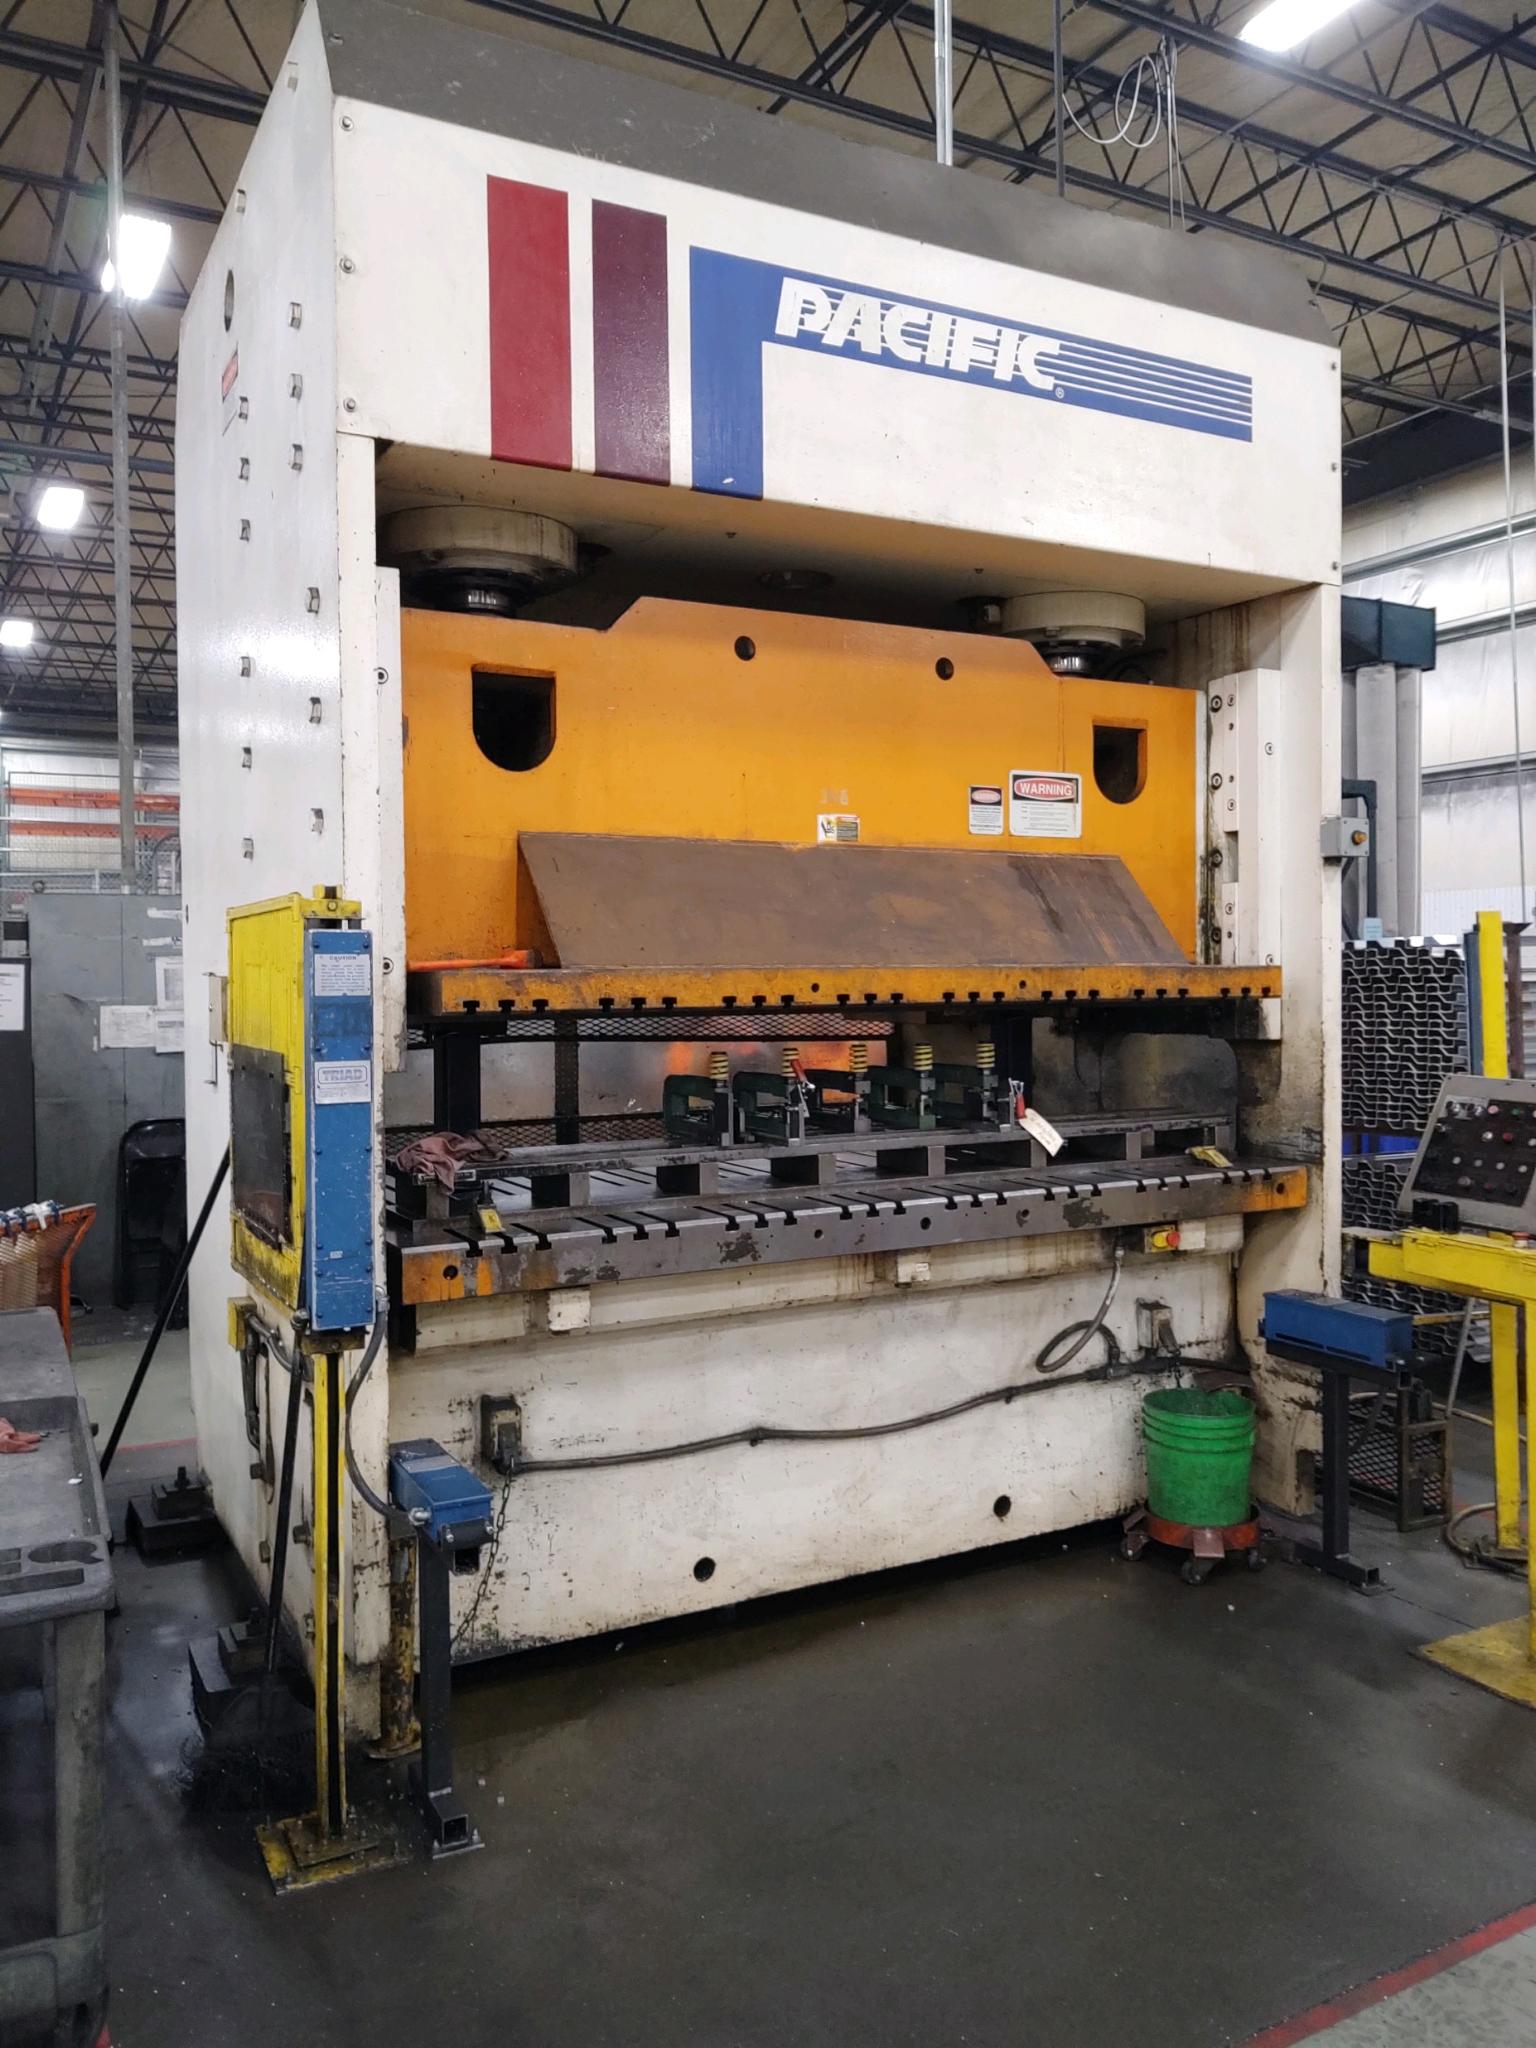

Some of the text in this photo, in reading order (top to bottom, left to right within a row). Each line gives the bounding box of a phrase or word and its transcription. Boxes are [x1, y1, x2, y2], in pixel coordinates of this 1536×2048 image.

[775, 277, 1060, 391] PACIFIC
[1019, 782, 1072, 796] WARNING
[322, 1068, 363, 1081] TRIAD
